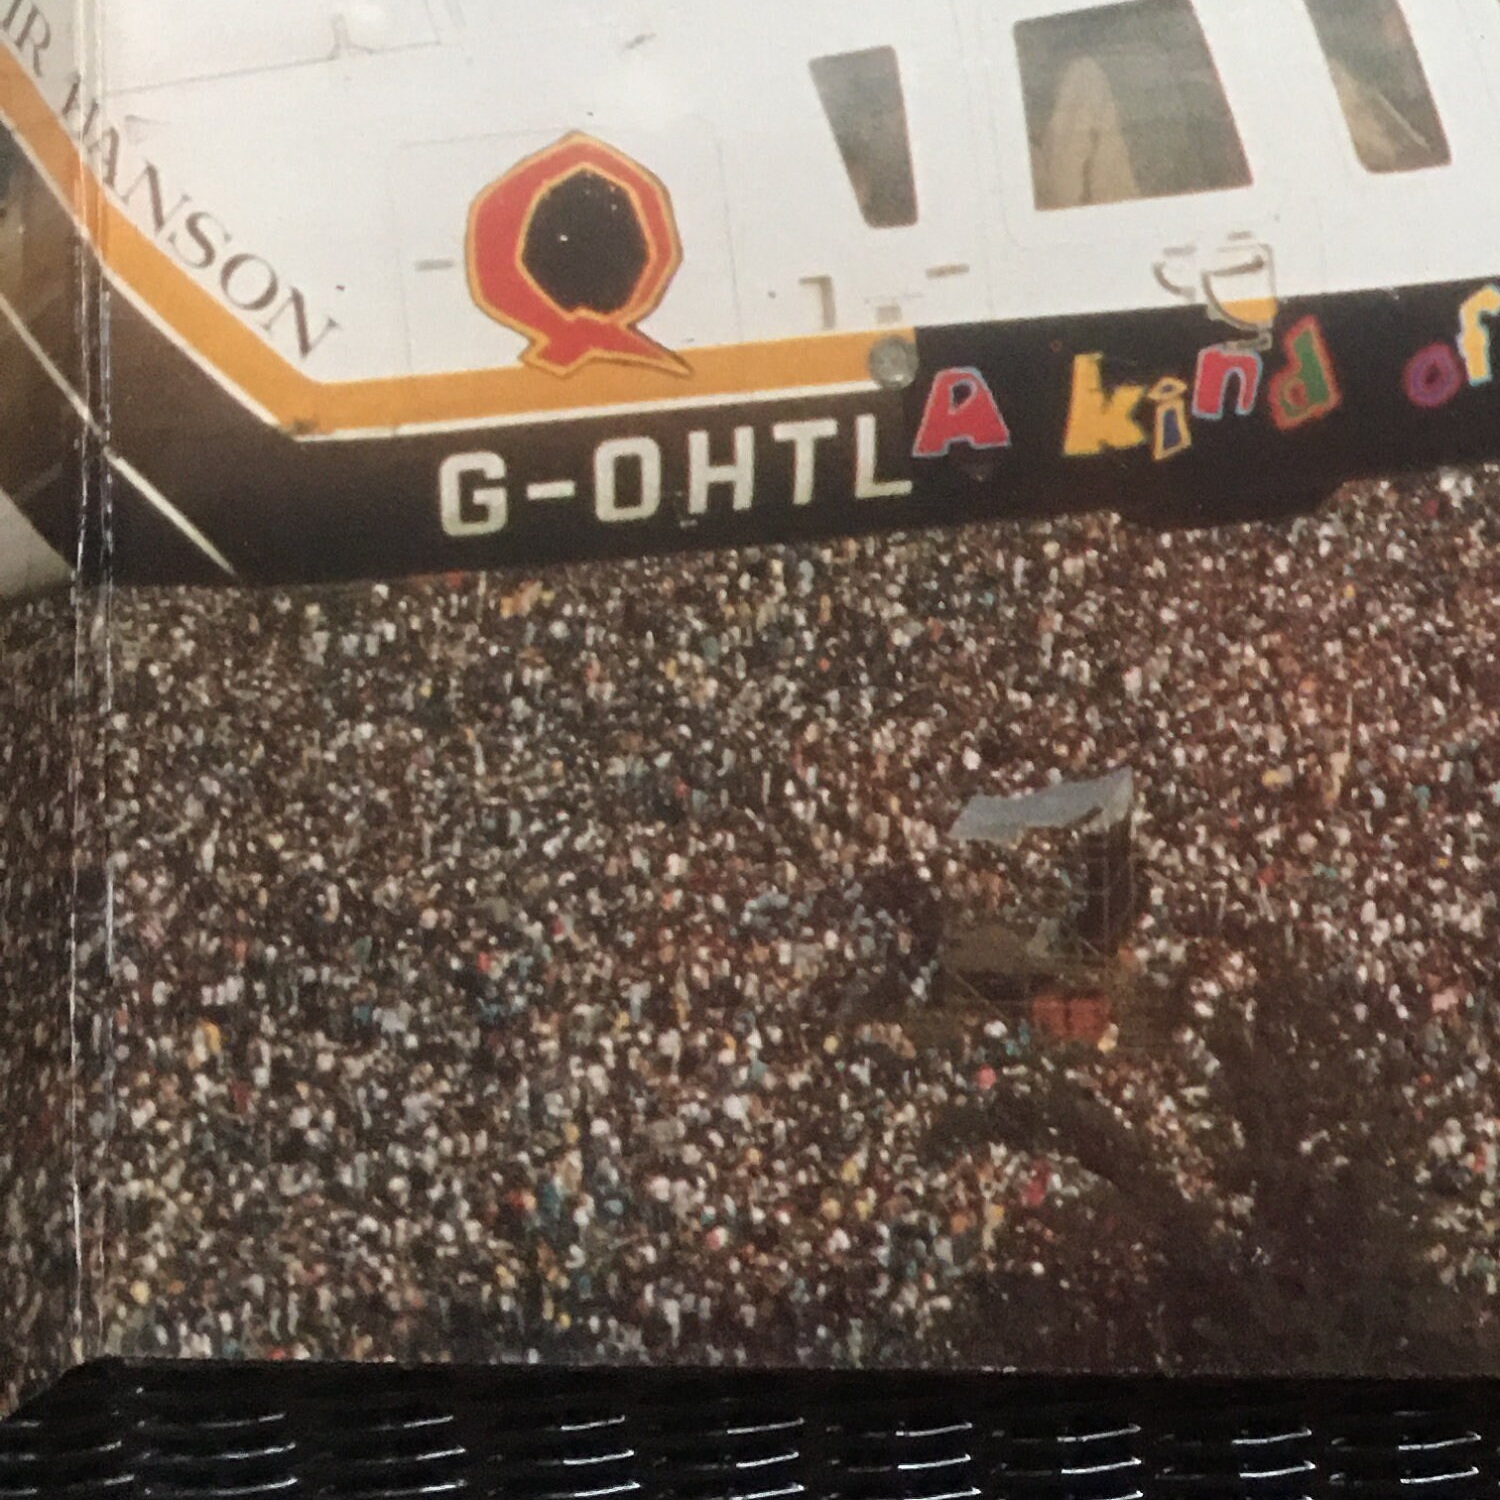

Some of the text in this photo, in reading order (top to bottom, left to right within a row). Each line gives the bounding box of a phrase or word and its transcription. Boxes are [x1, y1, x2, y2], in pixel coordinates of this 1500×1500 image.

[61, 68, 342, 359] HANSON
[465, 130, 694, 380] Q
[438, 413, 913, 537] G-OHTL
[912, 365, 1011, 458] A
[1062, 314, 1341, 460] kind
